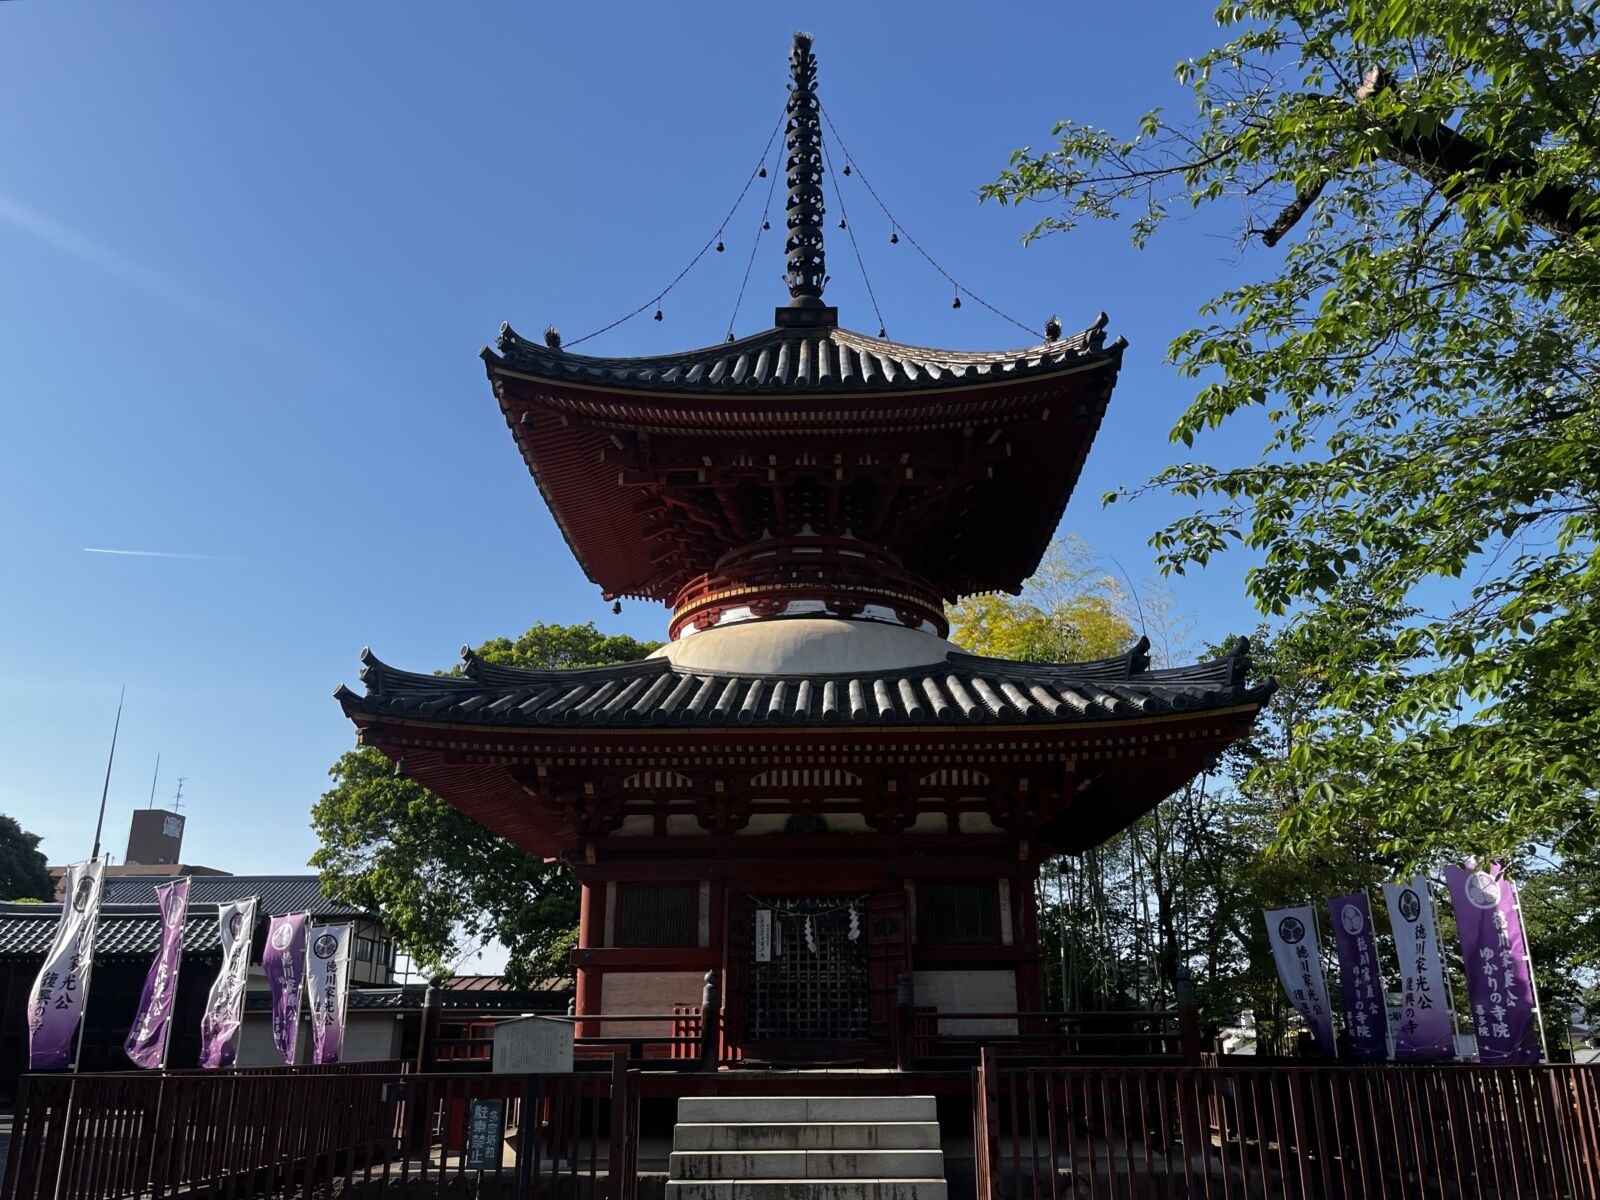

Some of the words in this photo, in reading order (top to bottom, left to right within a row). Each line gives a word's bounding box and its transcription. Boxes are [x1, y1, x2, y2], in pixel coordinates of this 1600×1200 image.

[325, 960, 338, 1027] 徳川家光公
[1295, 945, 1323, 1016] 徳川家光公
[1415, 924, 1433, 1010] 徳川家光公
[1479, 947, 1511, 1038] ゆかりの寺院
[30, 971, 59, 1035] 復興の寺
[1474, 1004, 1490, 1037] 喜多院
[469, 1104, 489, 1163] 駐車禁止
